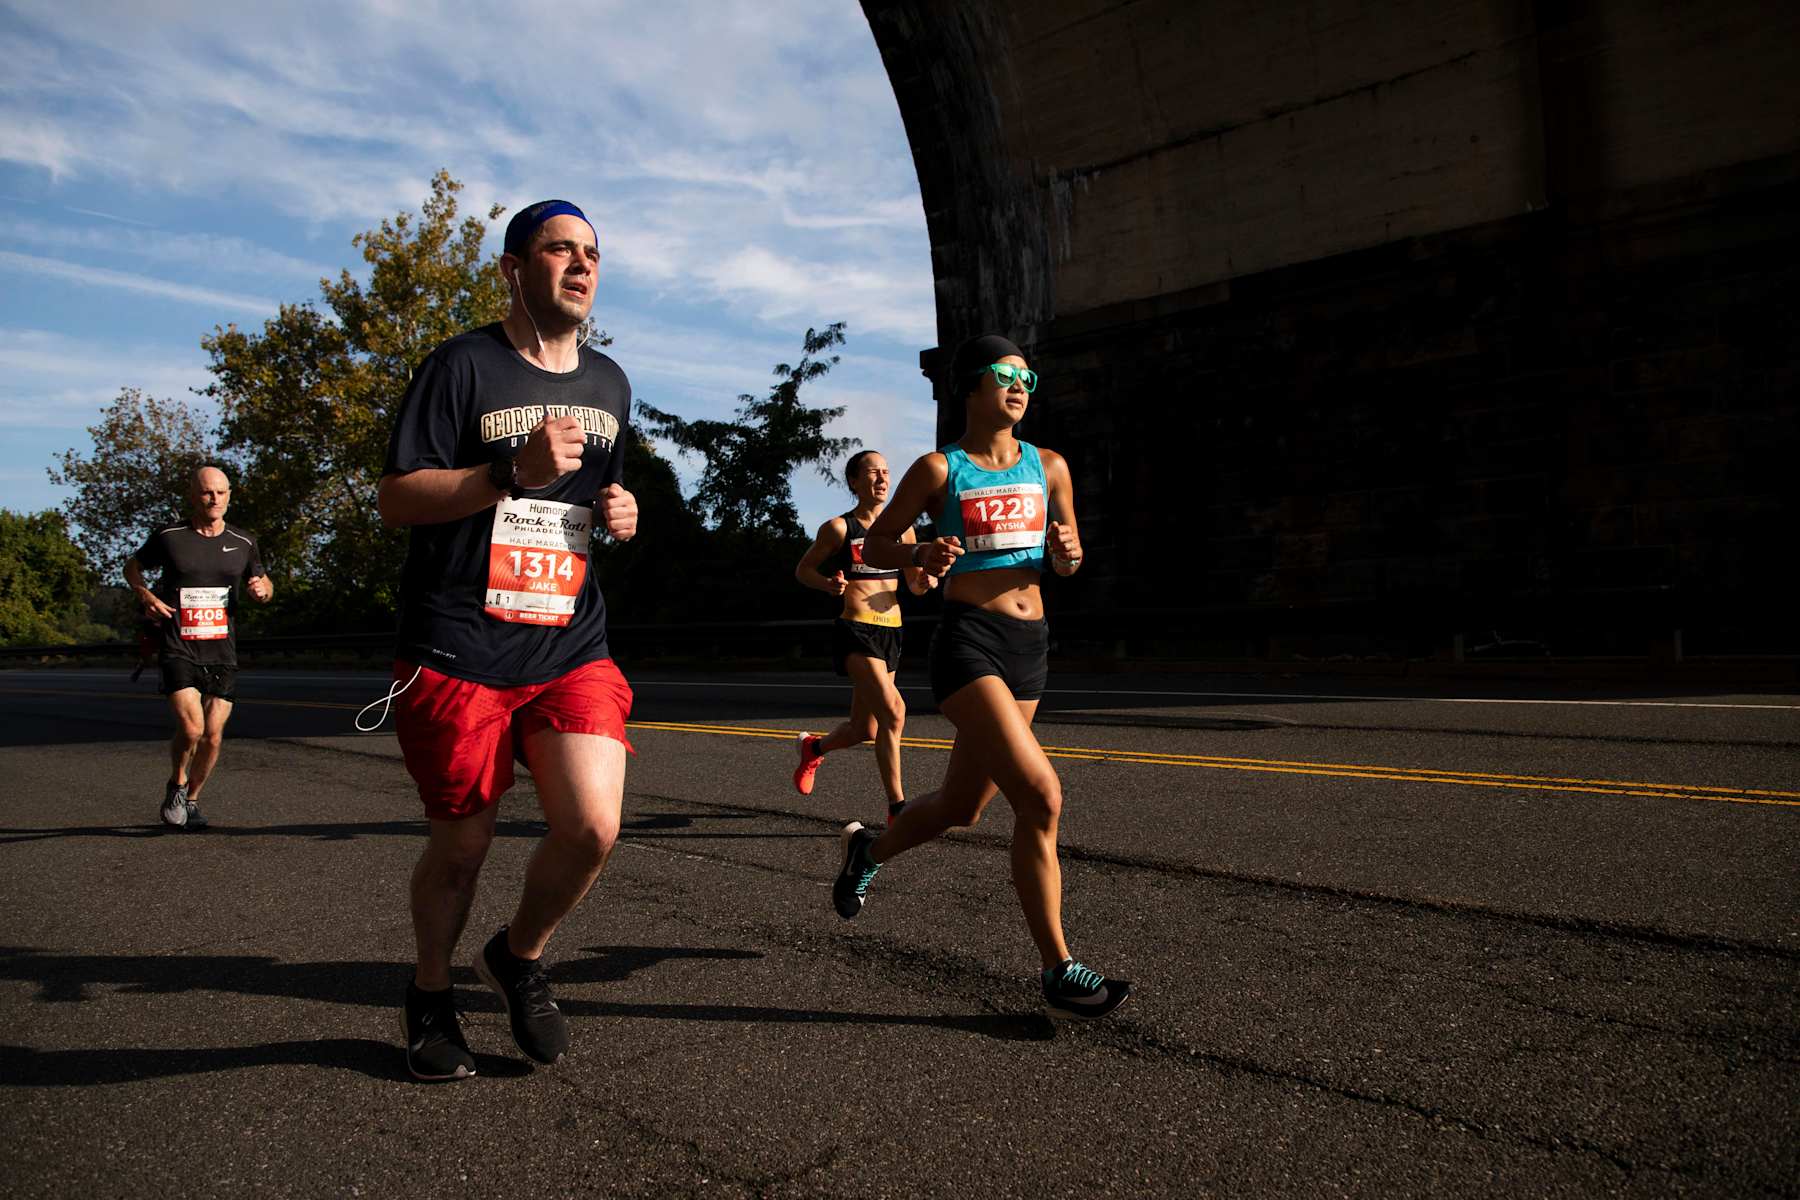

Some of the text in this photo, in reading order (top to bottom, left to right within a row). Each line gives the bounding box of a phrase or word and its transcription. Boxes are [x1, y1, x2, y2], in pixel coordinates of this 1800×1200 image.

[481, 405, 544, 443] GEORGE
[975, 497, 1037, 522] 1228
[503, 512, 545, 527] Rock
[559, 518, 587, 532] Roll
[995, 521, 1026, 531] AYSHA
[514, 525, 576, 537] PHILADELPHIA
[509, 537, 532, 546] HALF
[510, 550, 574, 581] 1314
[529, 581, 558, 592] JAKE
[186, 609, 224, 622] 1408
